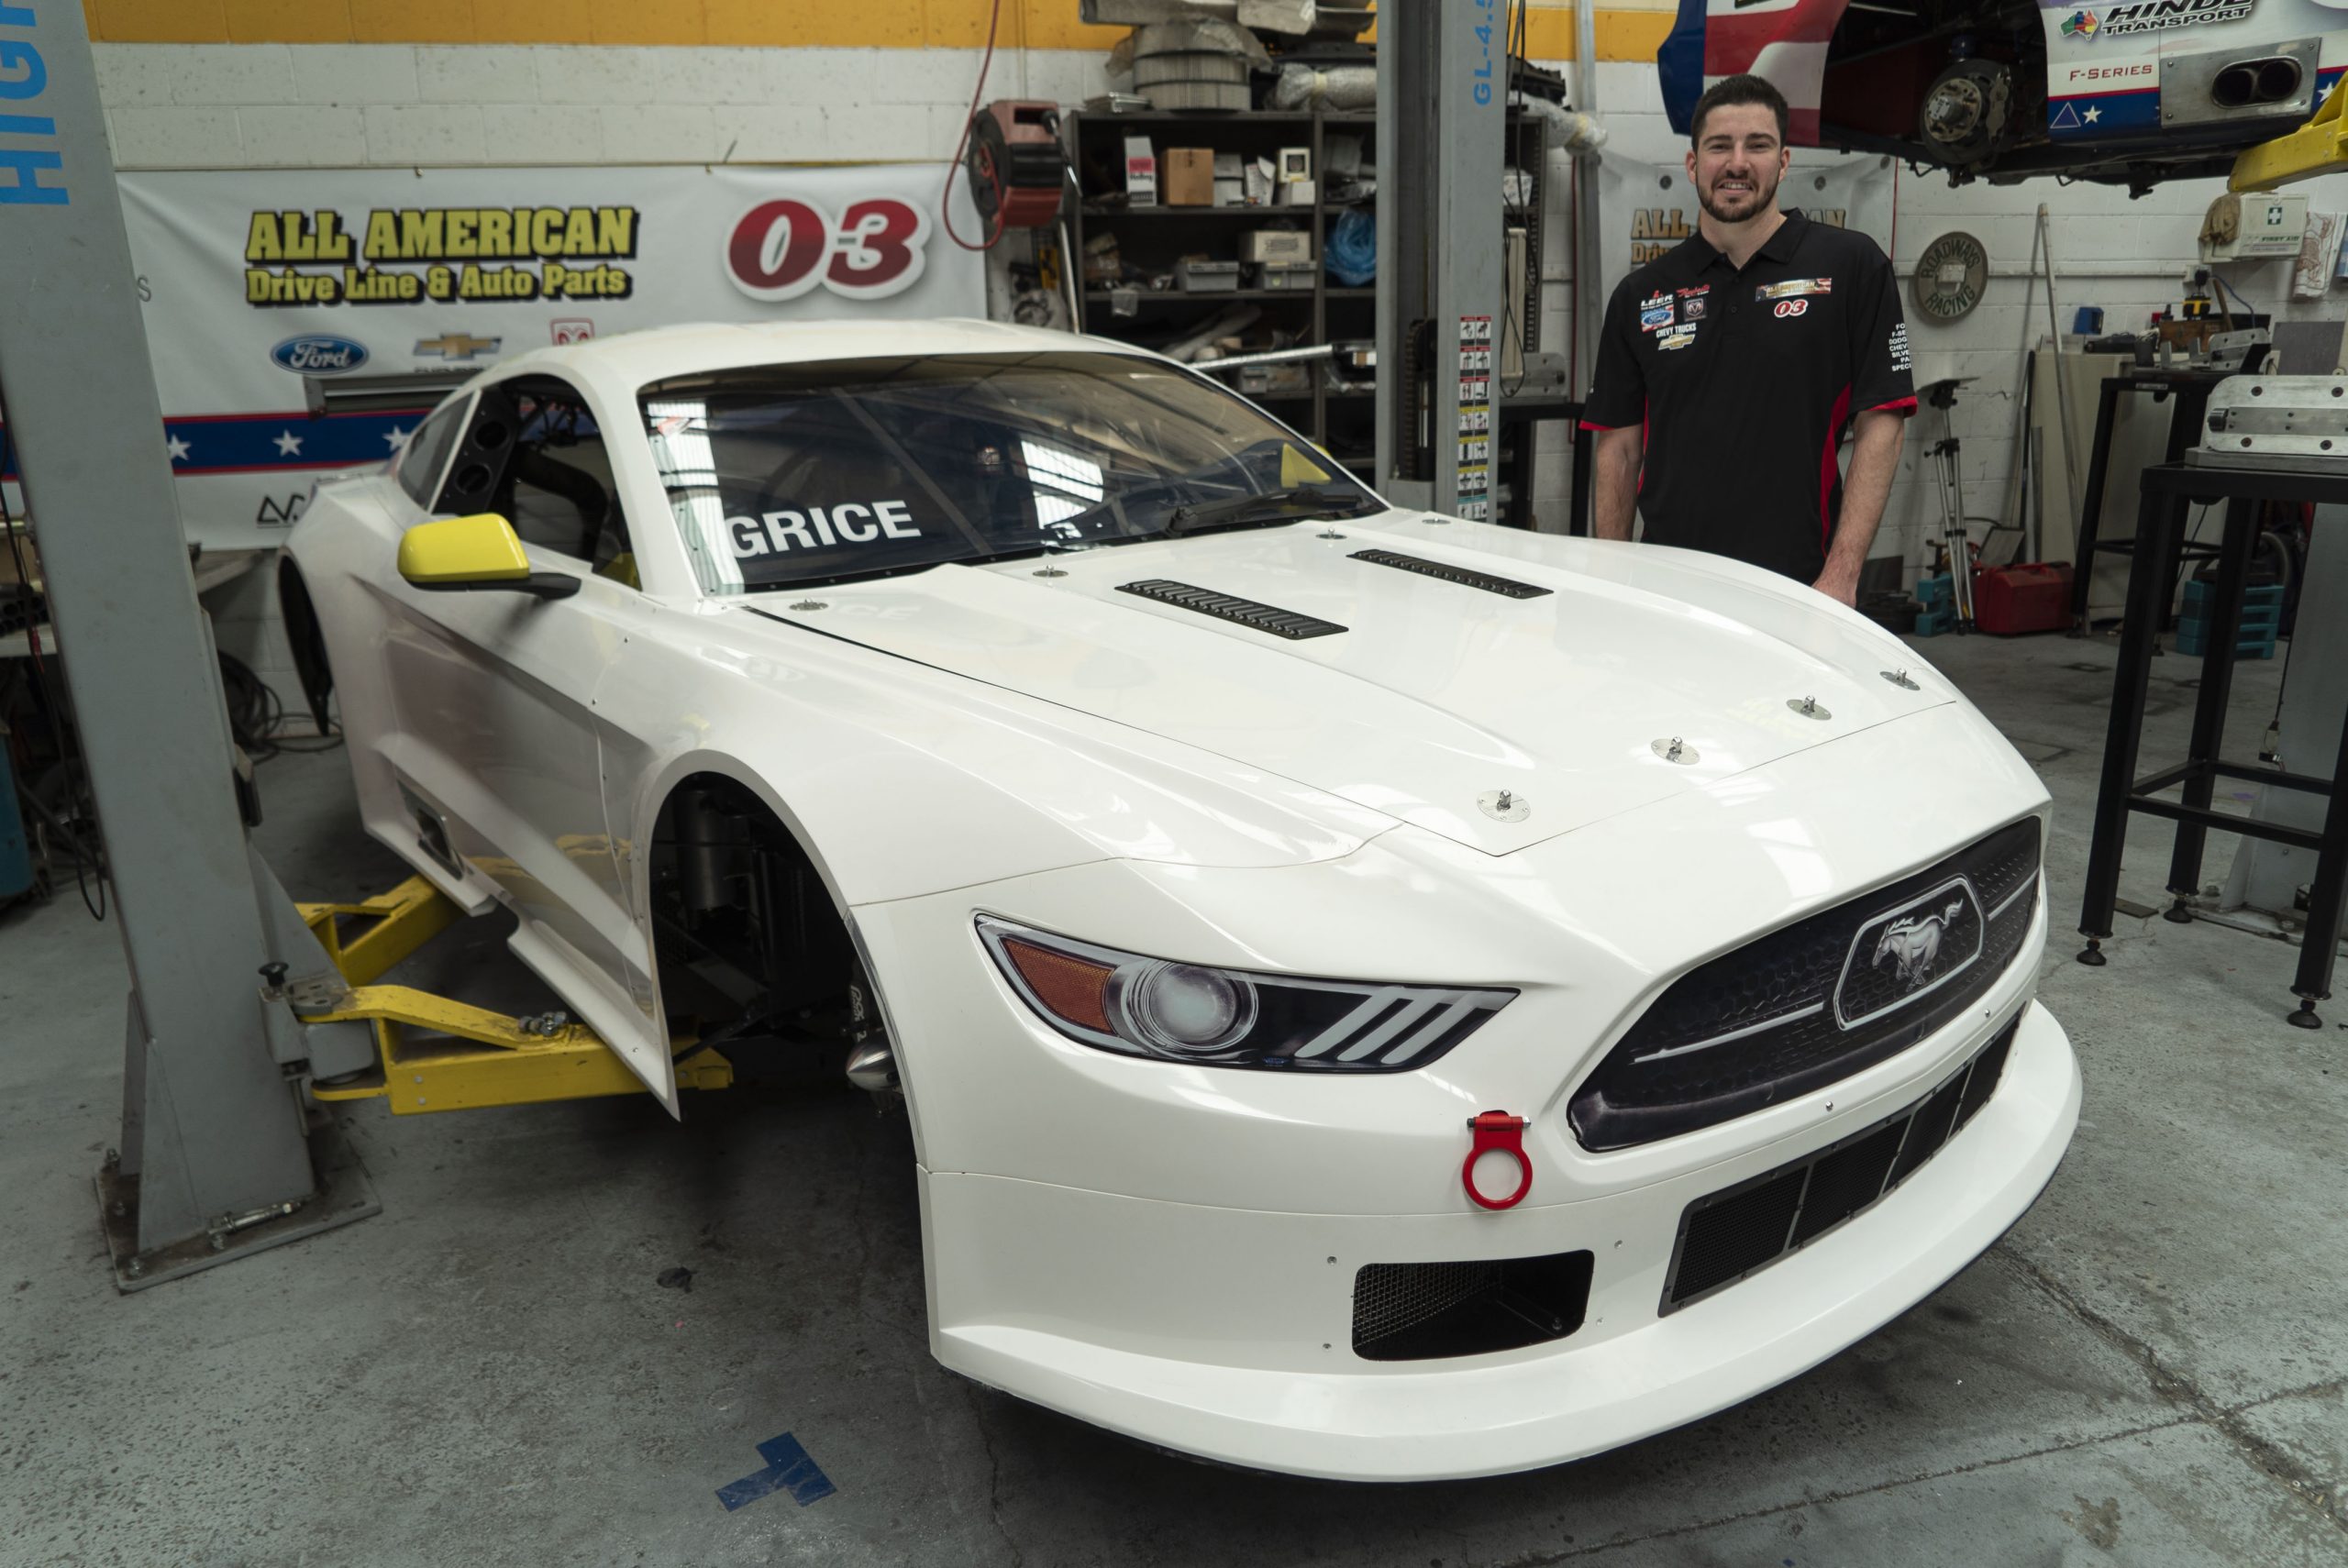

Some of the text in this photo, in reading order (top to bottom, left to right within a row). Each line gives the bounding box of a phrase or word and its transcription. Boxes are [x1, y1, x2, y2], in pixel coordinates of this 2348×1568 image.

[2103, 7, 2250, 36] TRANSPORT
[2104, 0, 2254, 24] HIND
[2069, 64, 2153, 82] F-SERIES
[245, 206, 639, 265] ALL AMERICAN
[1631, 208, 1691, 239] ALL
[728, 197, 920, 291] 03
[1921, 239, 1981, 279] ROADWAYS
[245, 261, 633, 307] Drive Line & Auto Parts
[1641, 294, 1674, 307] LEER
[1775, 300, 1808, 317] 03
[1926, 285, 1976, 316] RACING
[1656, 323, 1697, 338] CHEVY TRUCKS
[289, 340, 350, 369] Ford
[725, 500, 922, 559] GRICE
